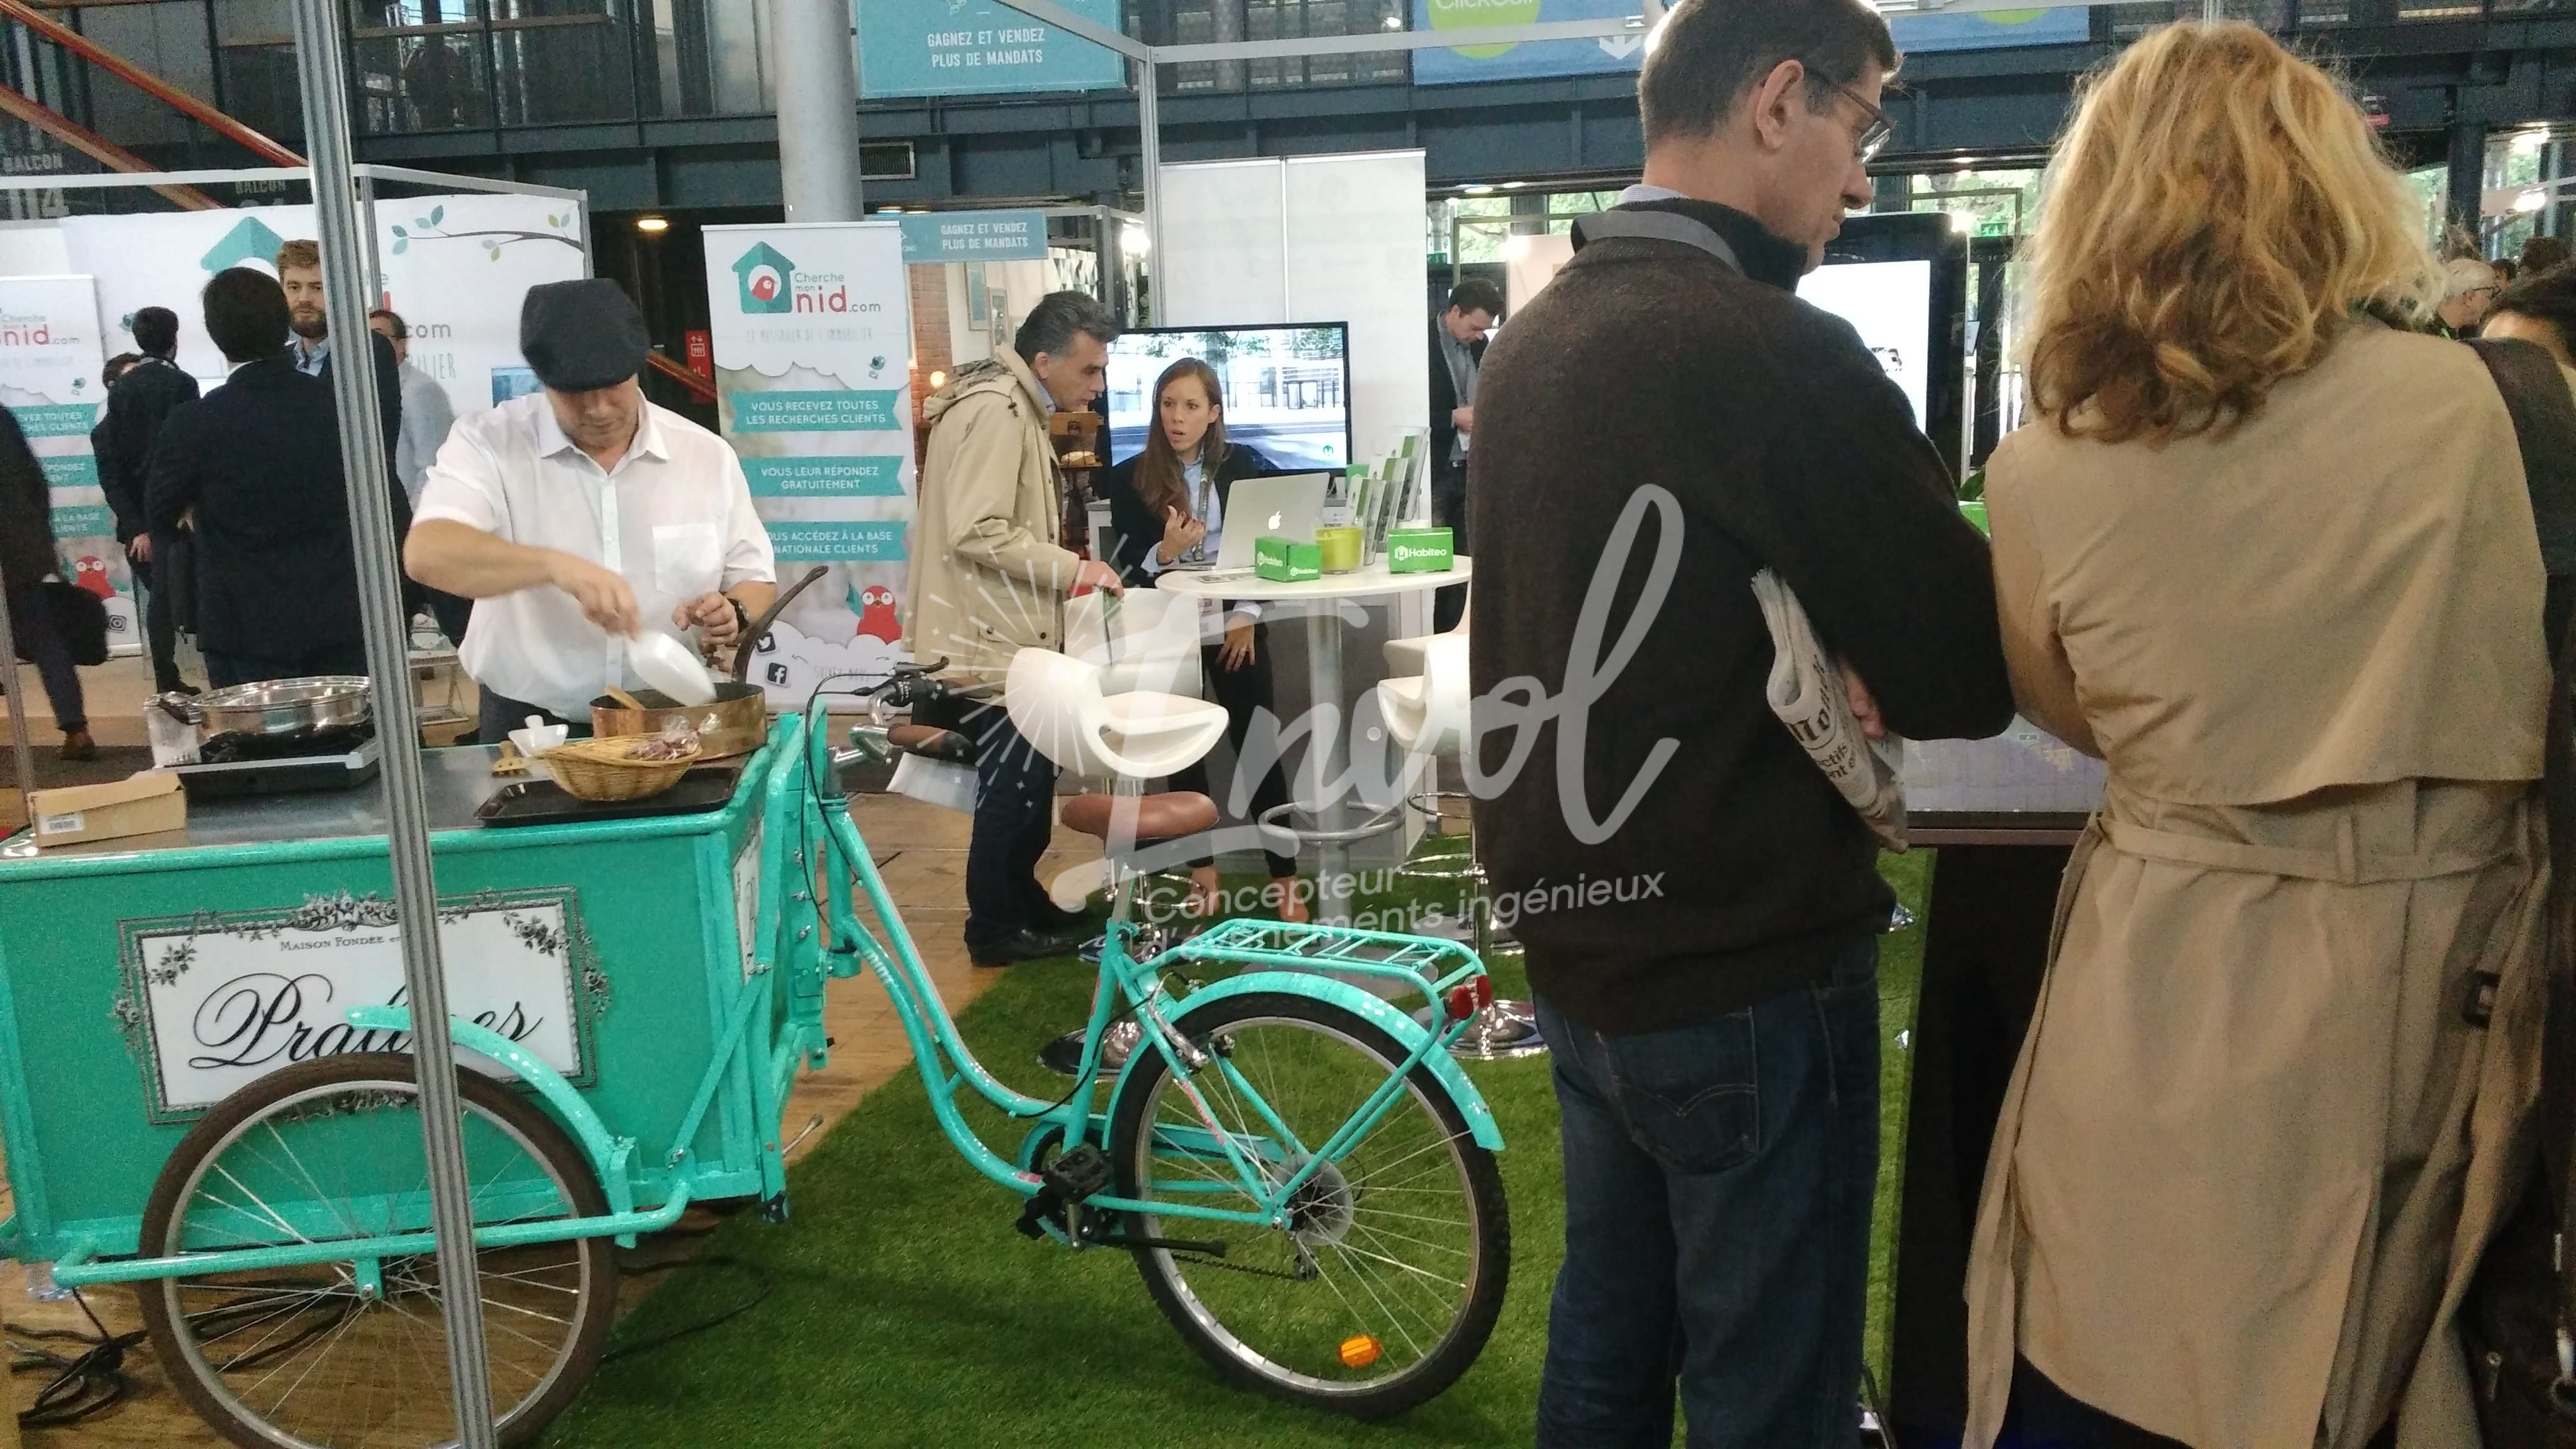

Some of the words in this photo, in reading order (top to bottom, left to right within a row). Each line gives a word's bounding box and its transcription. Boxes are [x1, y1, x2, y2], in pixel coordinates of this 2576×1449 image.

[927, 32, 973, 47] GAGNEZ
[979, 31, 992, 45] ET
[998, 28, 1045, 43] VENDEZ
[931, 53, 960, 68] PLUS
[966, 52, 981, 66] DE
[987, 50, 1043, 65] MANDATS
[940, 224, 975, 235] GAGNEZ
[978, 223, 989, 234] ET
[993, 221, 1028, 233] VENDEZ
[942, 239, 965, 250] PLUS
[969, 238, 981, 249] DE
[985, 236, 1028, 248] MANDATS
[794, 272, 844, 283] Cherche
[751, 401, 783, 412] VOUS
[786, 401, 833, 411] RECEVEZ
[836, 400, 879, 411] TOUTES
[746, 414, 766, 425] LES
[768, 414, 838, 425] RECHERCHES
[840, 413, 886, 423] CLIENTS
[761, 467, 792, 478] VOUS
[795, 467, 821, 477] LEUR
[824, 464, 879, 477] RÉPONDEZ
[780, 479, 860, 491] GRATUITEMENT
[791, 530, 840, 542] ACCÉDEZ
[851, 531, 865, 541] LA
[867, 531, 892, 541] BASE
[774, 543, 831, 554] NATIONALE
[834, 543, 879, 554] CLIENTS
[1408, 547, 1447, 557] Habiteo
